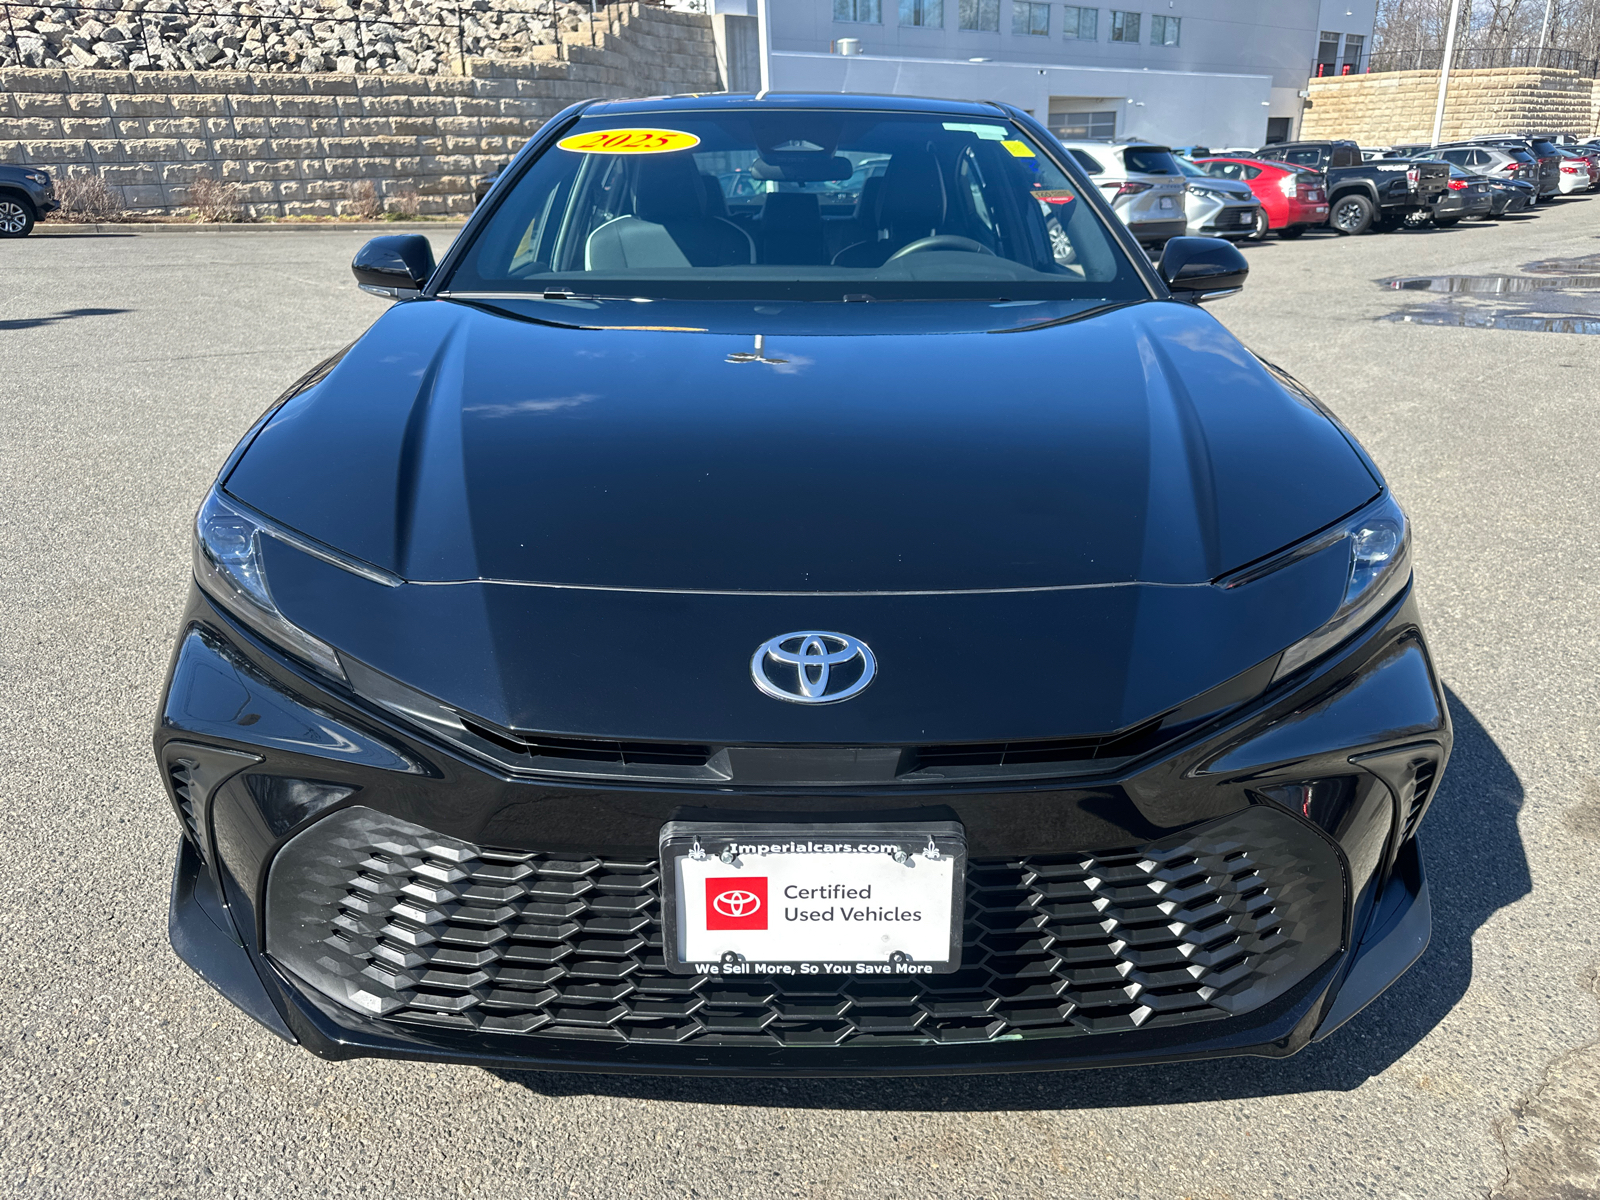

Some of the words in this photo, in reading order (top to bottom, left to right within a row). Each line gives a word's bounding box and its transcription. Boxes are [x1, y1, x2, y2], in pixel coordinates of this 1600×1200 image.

[576, 133, 679, 148] 2025
[730, 841, 898, 855] Imperialcars.com
[784, 884, 872, 899] Certified
[784, 906, 835, 922] Used
[840, 906, 922, 922] Vehicles
[694, 963, 719, 974] We
[722, 963, 750, 974] Sell
[754, 963, 796, 976] More,
[799, 963, 820, 974] So
[823, 963, 852, 974] You
[855, 963, 892, 974] Save
[895, 963, 933, 974] More
